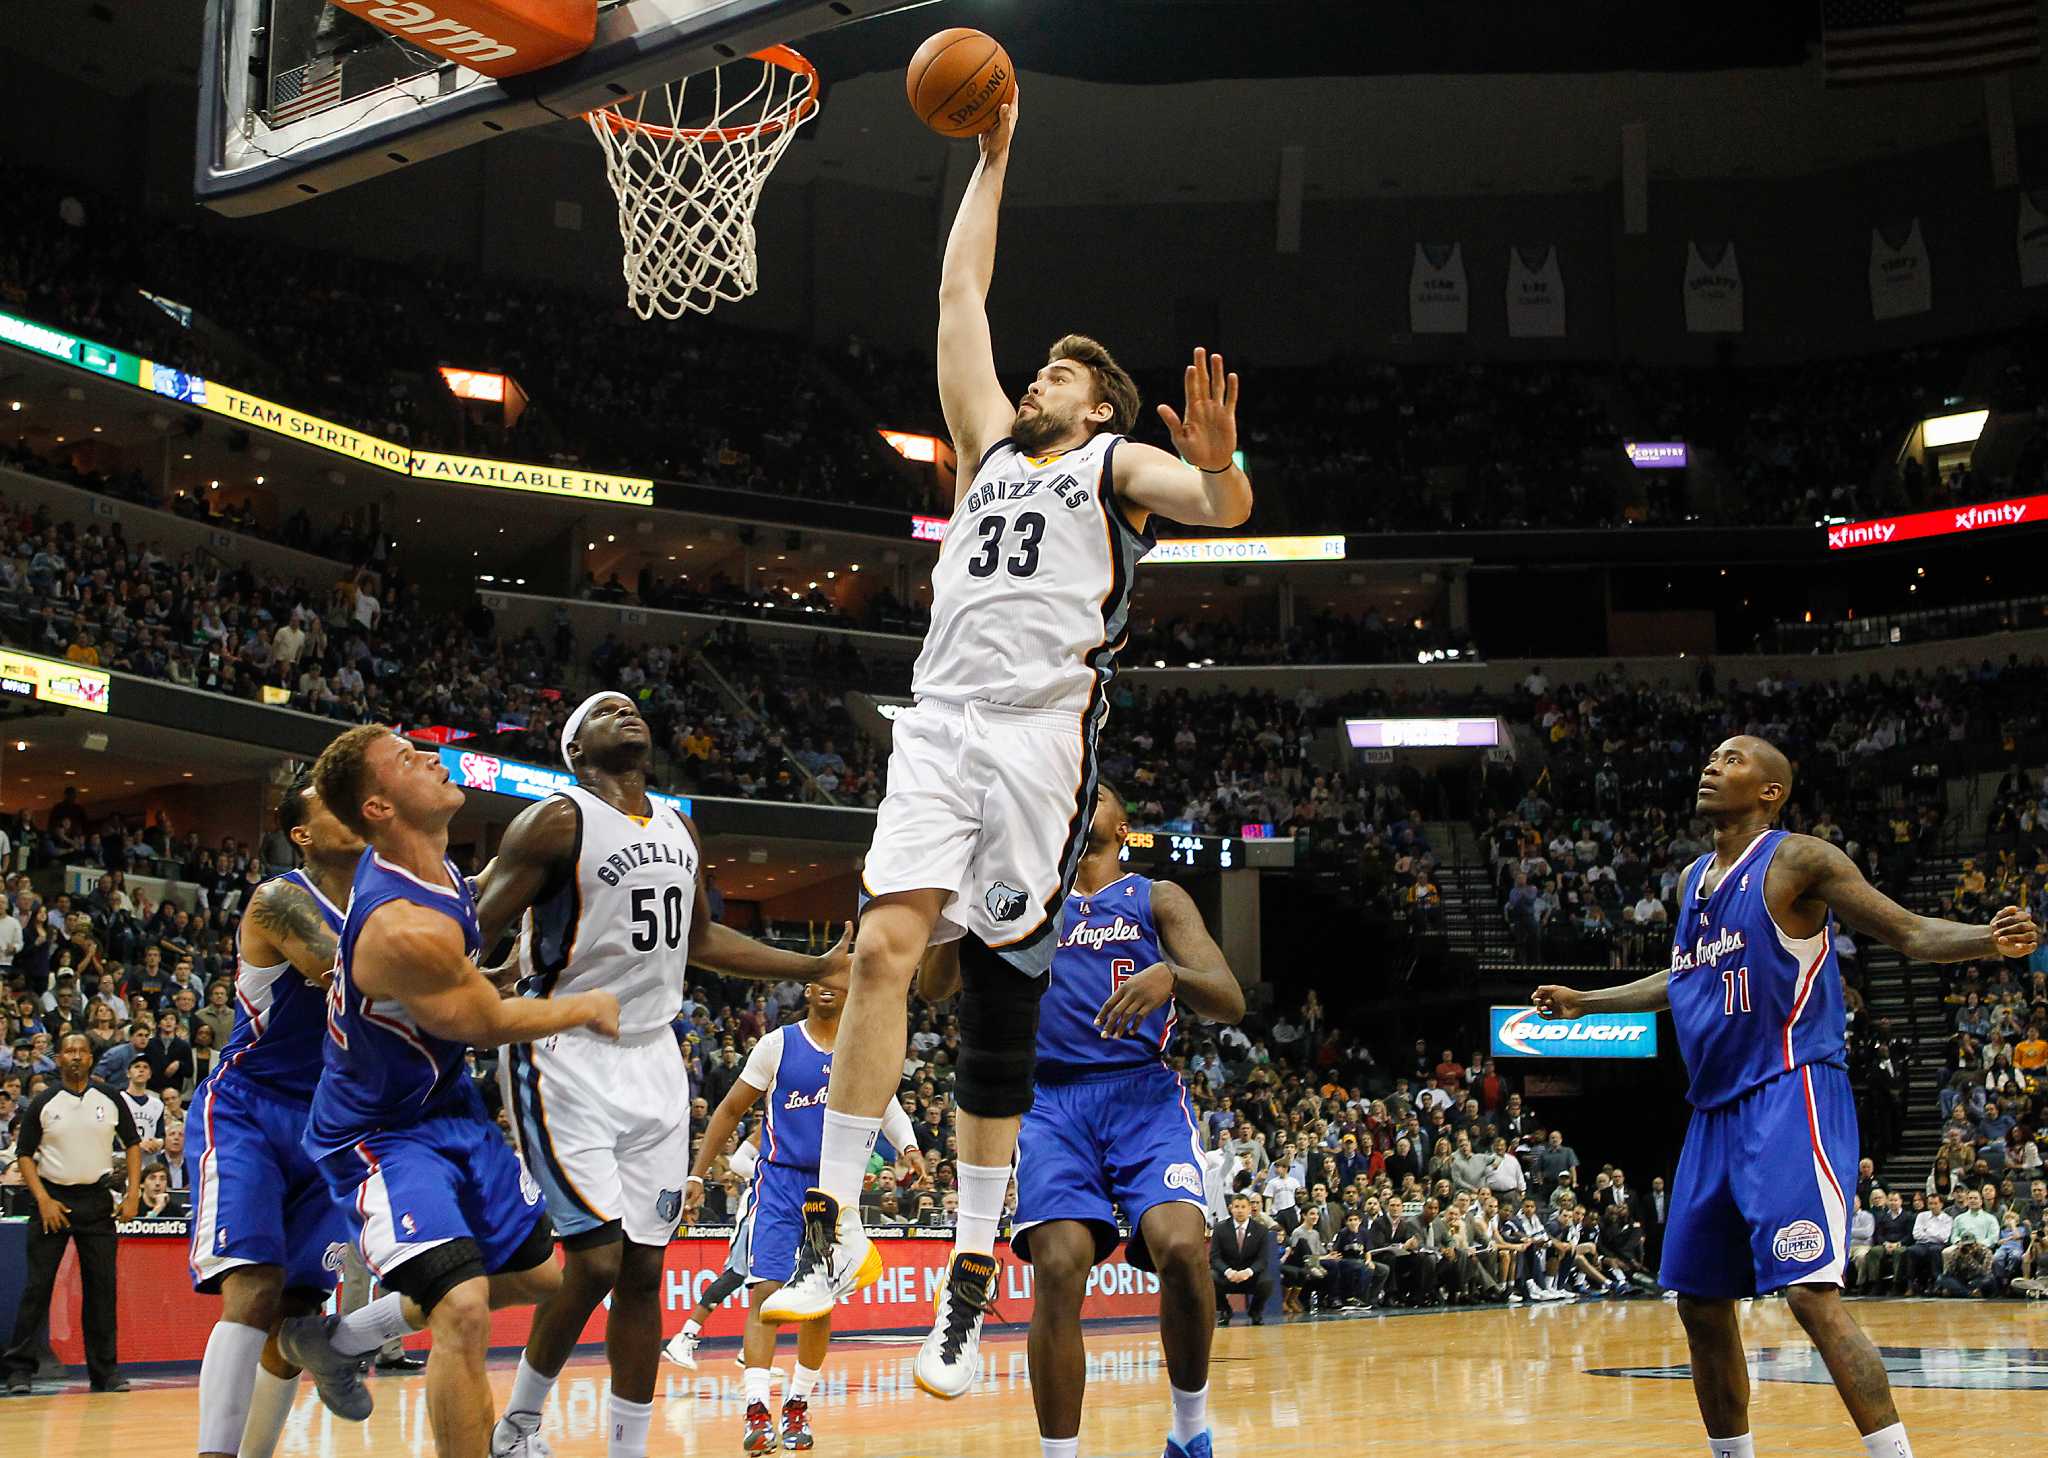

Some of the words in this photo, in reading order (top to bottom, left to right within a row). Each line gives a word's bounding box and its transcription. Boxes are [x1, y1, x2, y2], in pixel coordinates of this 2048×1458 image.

[947, 64, 1006, 124] SPALDING
[226, 395, 282, 427] TEAM
[290, 417, 366, 457] SPIRIT,
[373, 445, 427, 471] NOW
[435, 461, 574, 490] AVAILABLE
[582, 478, 610, 494] IN
[1635, 447, 1684, 456] COVENTRY
[967, 474, 1090, 512] GRIZZIES
[1955, 504, 2027, 529] xfinity
[968, 512, 1046, 578] 33
[1205, 543, 1268, 557] TOYOTA
[1828, 523, 1896, 548] xfinity
[631, 885, 683, 952] 50
[1065, 916, 1141, 951] Angeles
[1670, 945, 1696, 974] Los
[1695, 927, 1745, 968] Angeles
[1721, 966, 1752, 1016] 11
[1512, 1022, 1568, 1041] BUD
[1568, 1022, 1648, 1042] LIGHT
[784, 1090, 813, 1110] Los
[961, 1260, 993, 1276] MARC
[1086, 1263, 1161, 1296] PORTS
